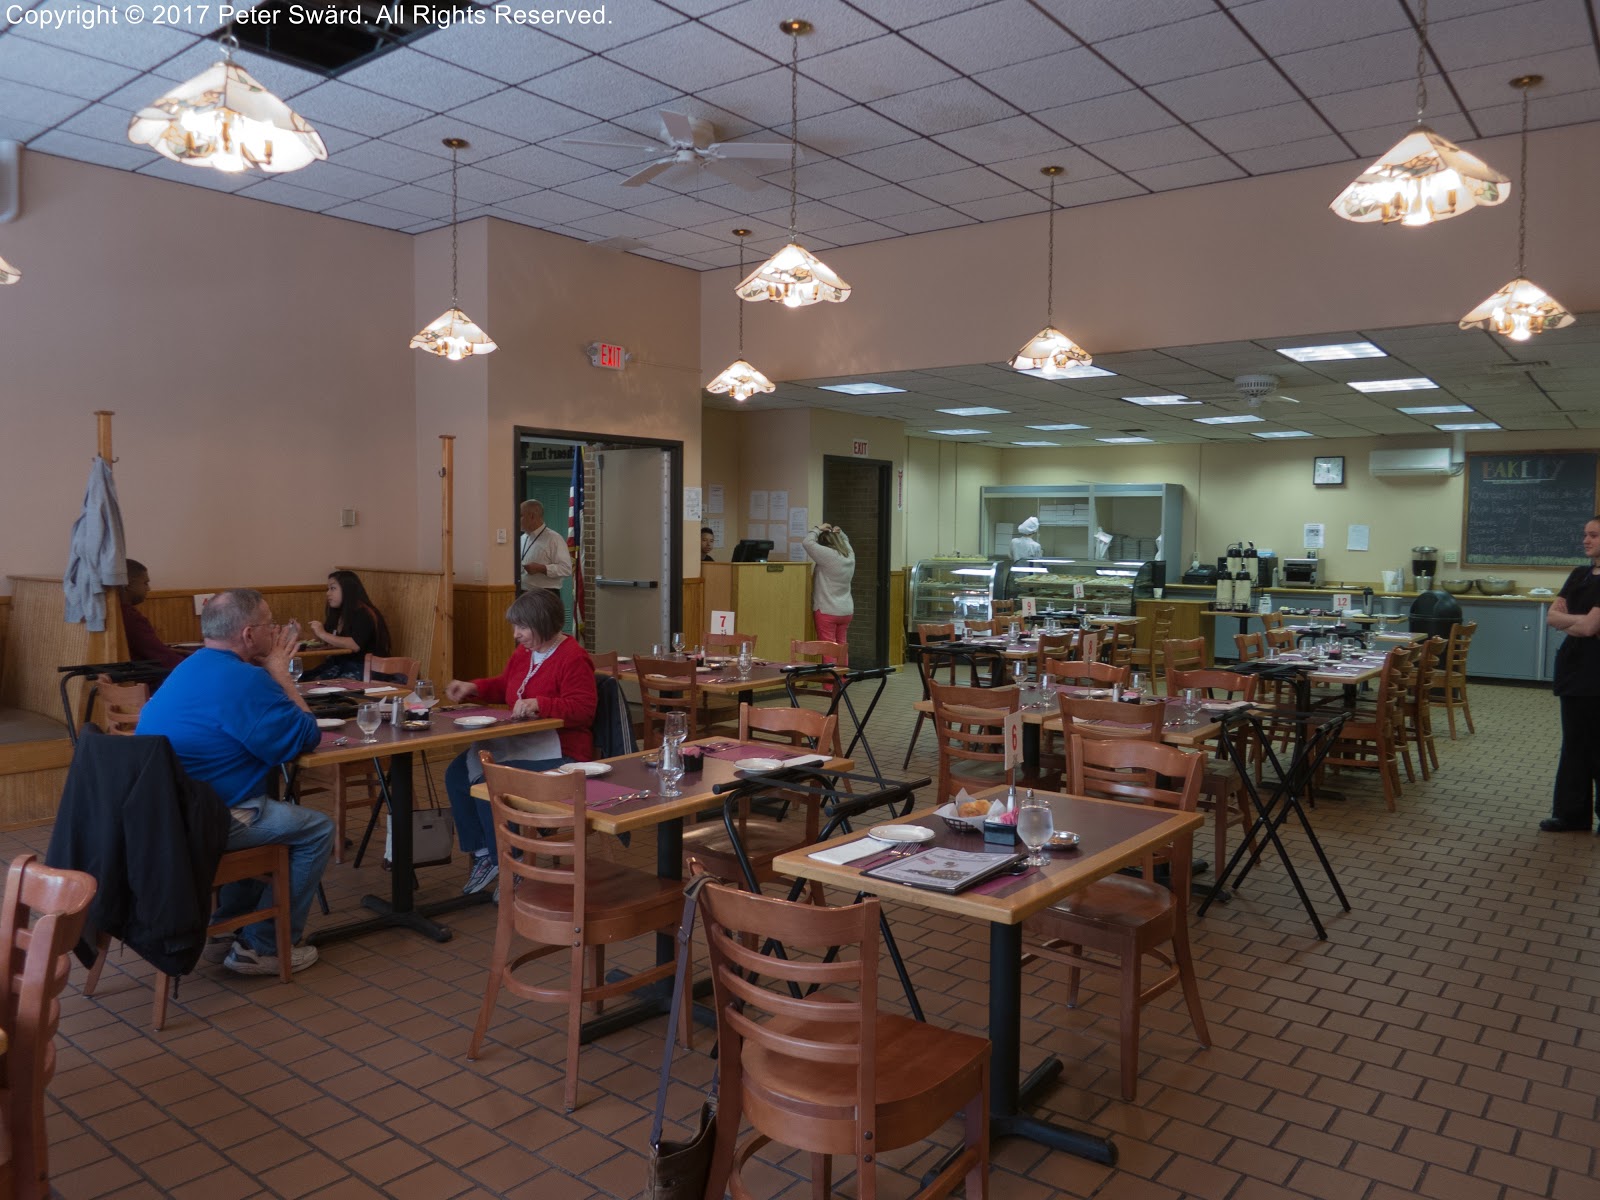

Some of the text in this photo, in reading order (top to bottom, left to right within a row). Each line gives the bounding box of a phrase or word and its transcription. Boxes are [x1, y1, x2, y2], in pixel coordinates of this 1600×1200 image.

[602, 344, 621, 368] EXIT
[854, 441, 868, 455] EXIT
[1482, 458, 1565, 479] BAKERY
[1337, 597, 1348, 606] 12
[719, 615, 727, 628] 7
[1088, 640, 1093, 655] 8
[1011, 724, 1018, 751] 6
